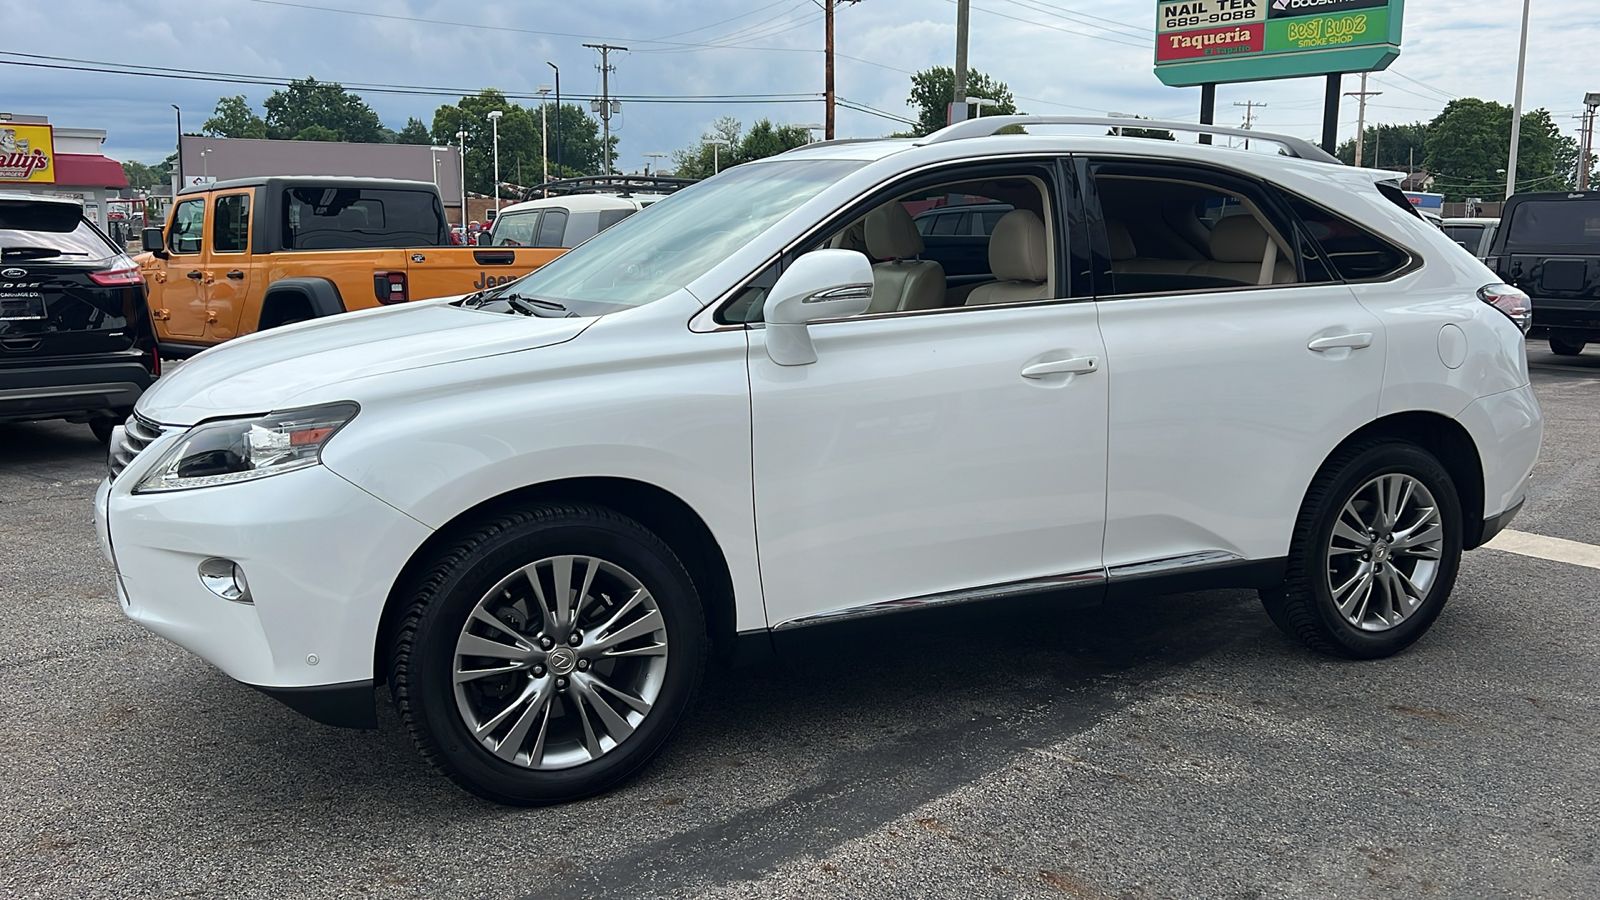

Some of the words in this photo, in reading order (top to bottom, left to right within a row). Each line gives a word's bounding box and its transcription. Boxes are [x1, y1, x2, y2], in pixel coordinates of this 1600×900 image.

[1165, 3, 1207, 18] NAIL
[1217, 0, 1257, 11] TEK
[1166, 9, 1256, 28] 689-9088
[1298, 37, 1327, 47] SMOKE
[1329, 35, 1353, 45] SHOP
[1204, 47, 1213, 55] El
[0, 149, 47, 177] ally's
